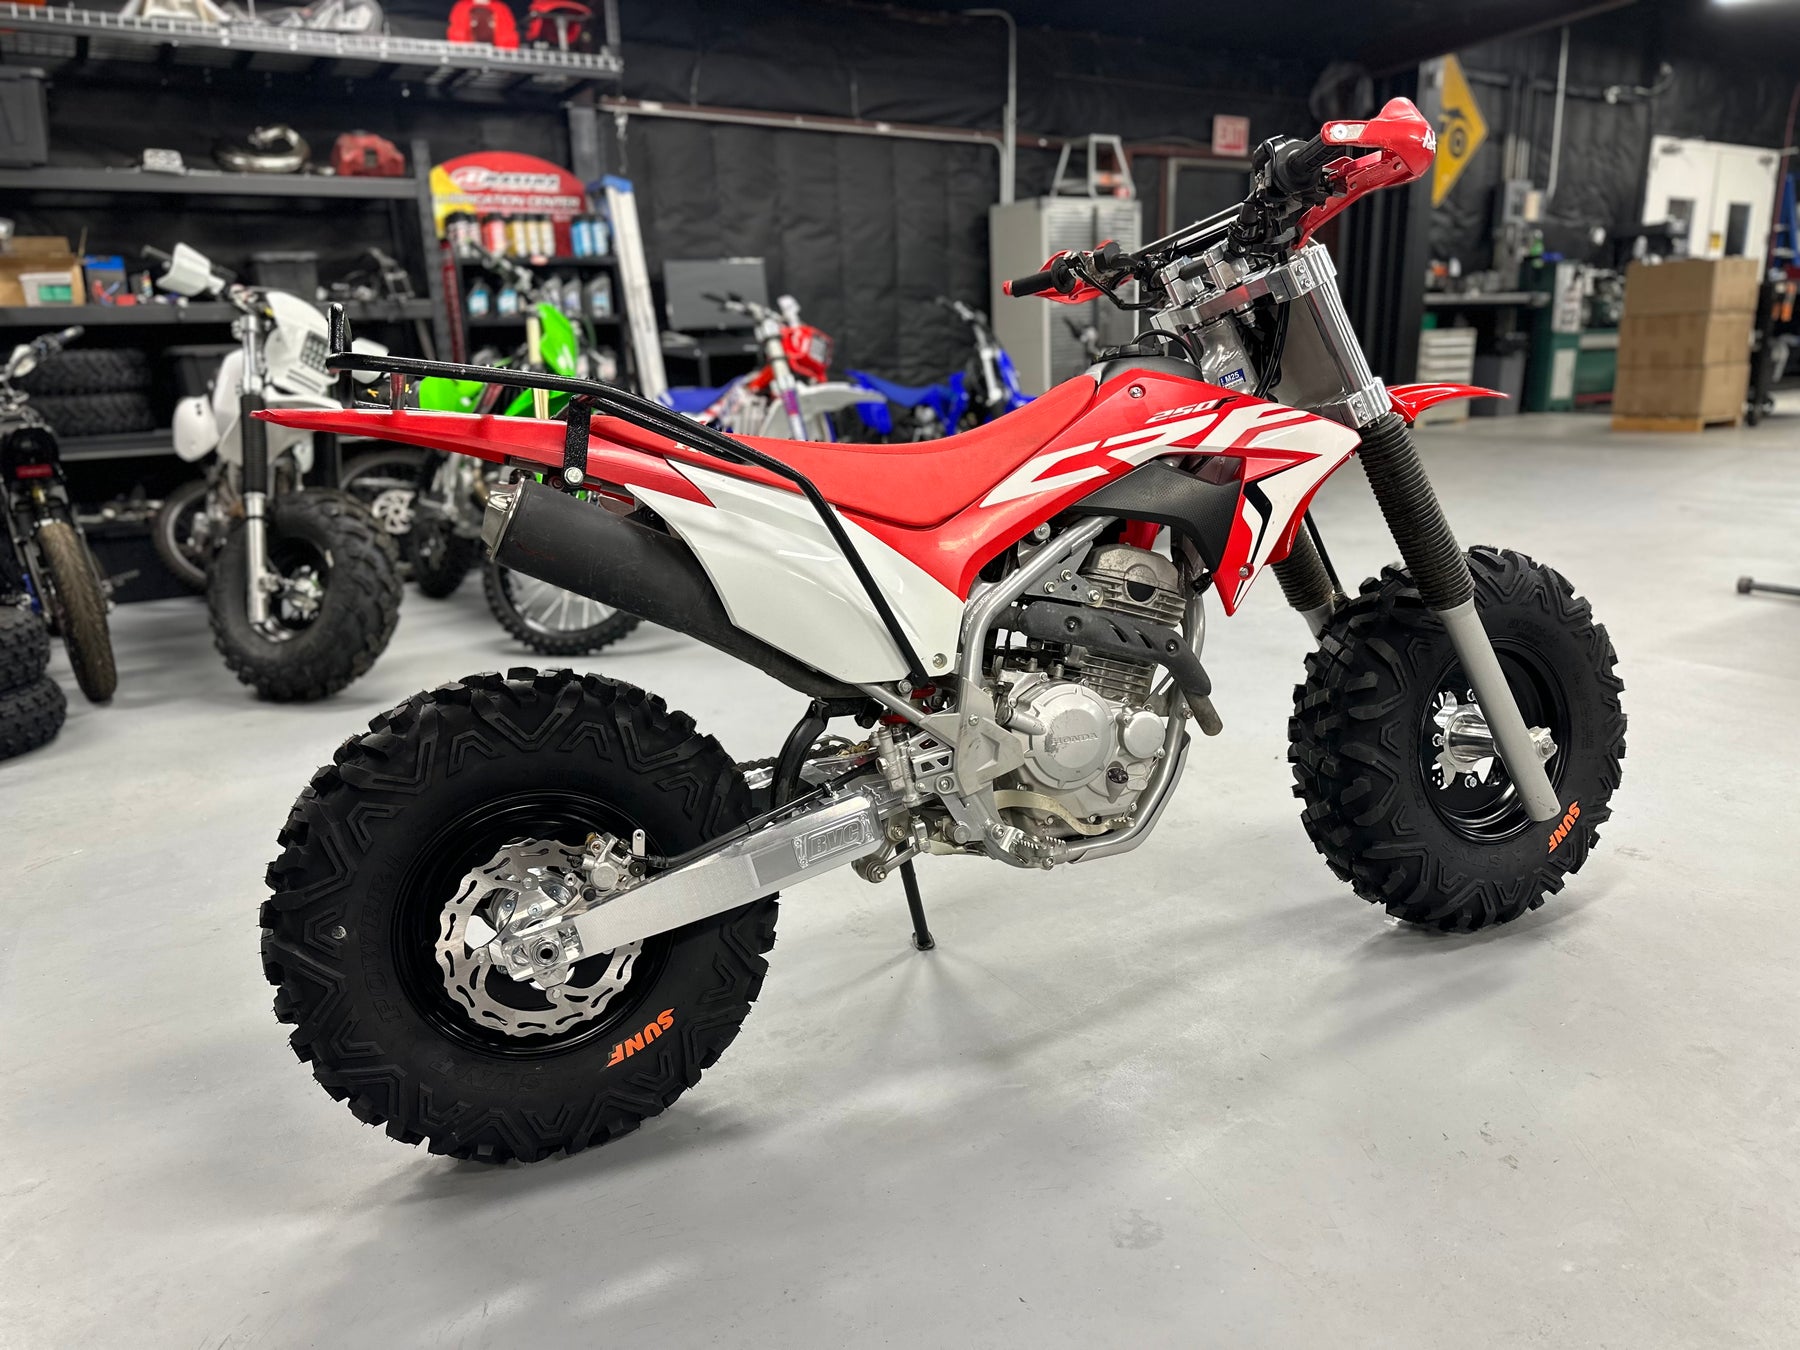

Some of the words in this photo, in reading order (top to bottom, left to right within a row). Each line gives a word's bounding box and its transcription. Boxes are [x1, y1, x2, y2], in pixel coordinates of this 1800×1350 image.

[1225, 371, 1240, 382] M25
[1145, 396, 1241, 425] 250F
[1052, 732, 1098, 746] HONDA
[811, 822, 861, 853] BVC
[1549, 801, 1580, 854] SUNF
[605, 1008, 675, 1068] SUNF
